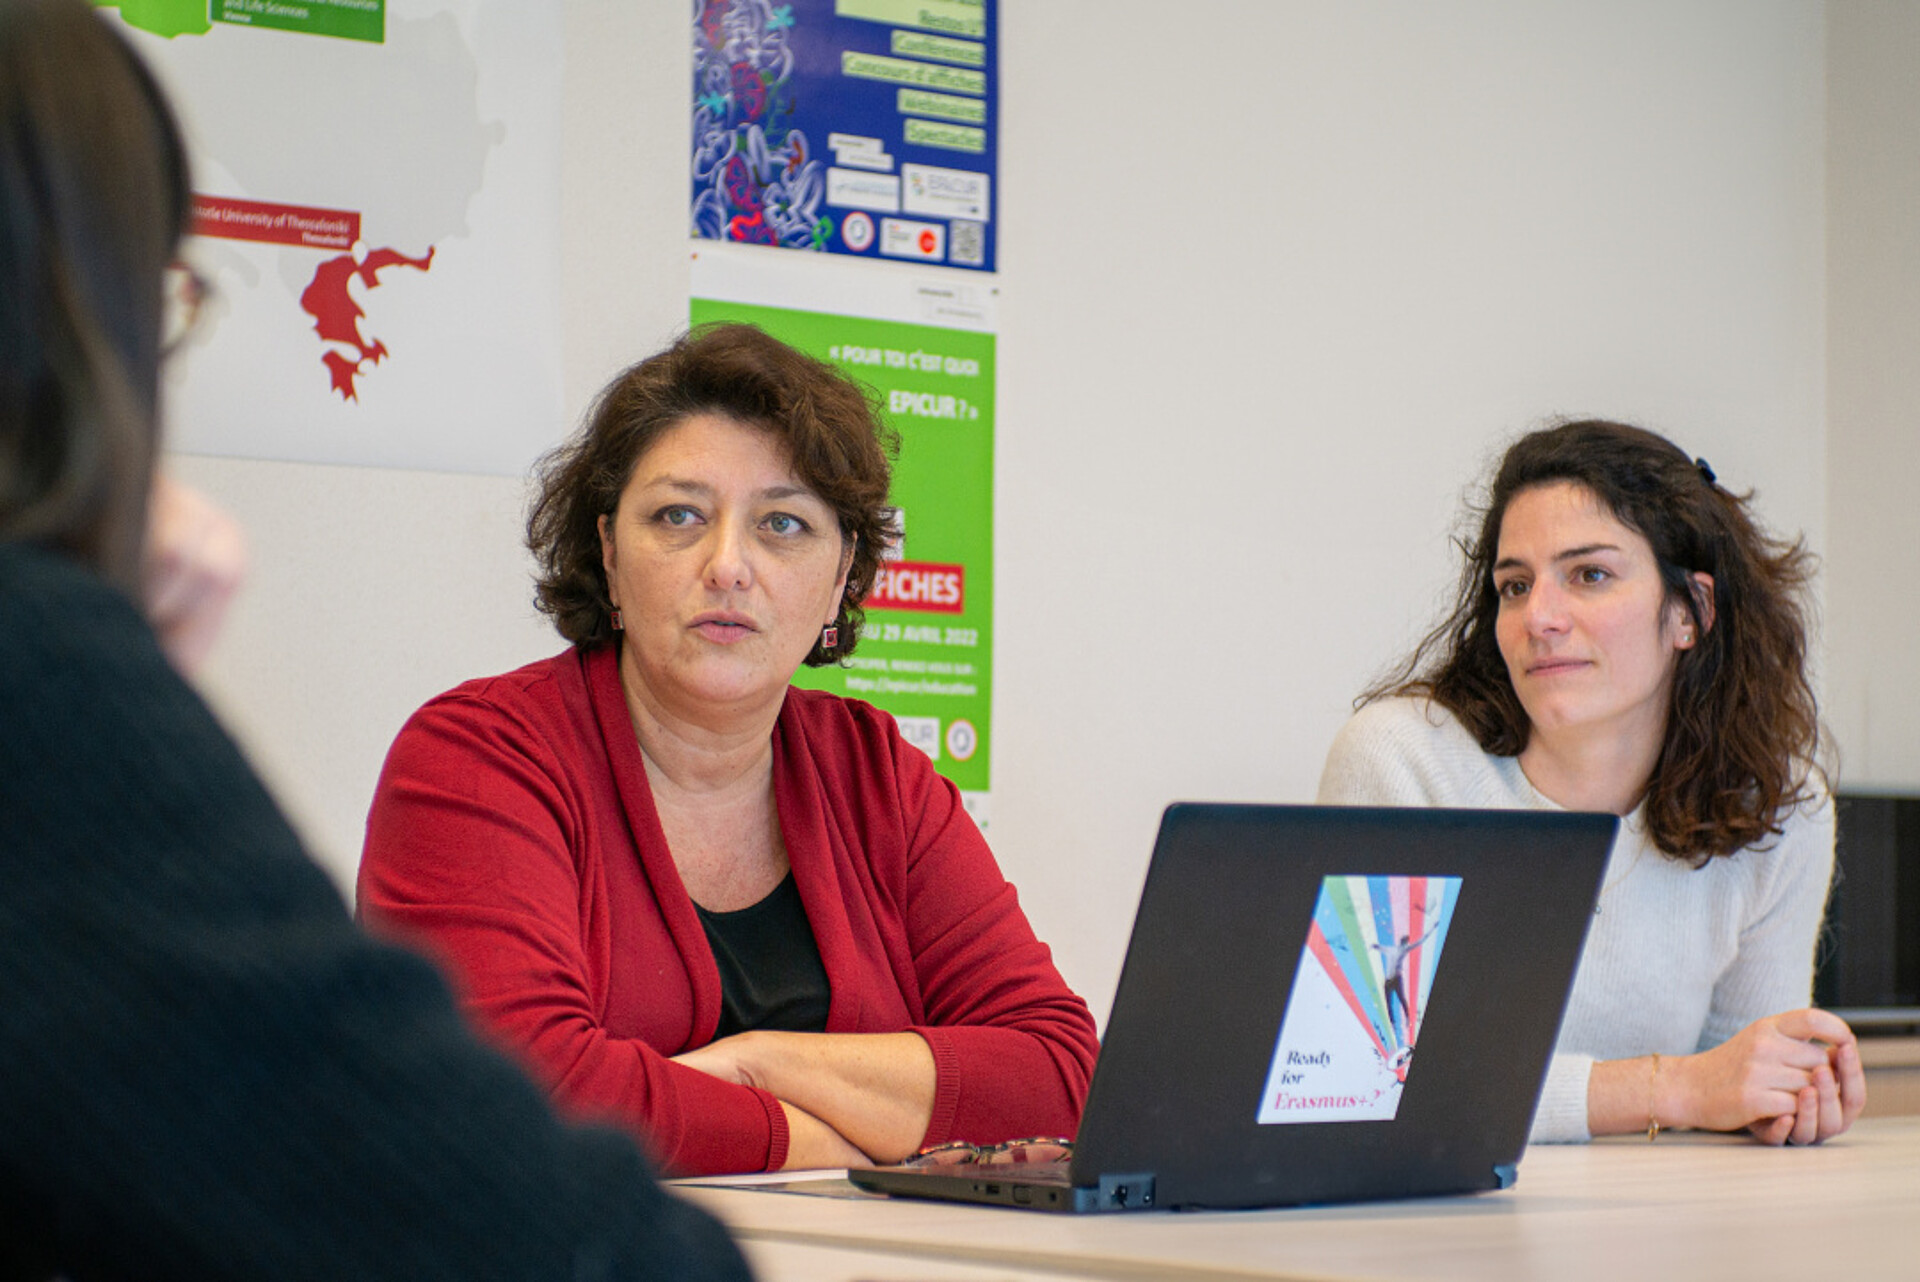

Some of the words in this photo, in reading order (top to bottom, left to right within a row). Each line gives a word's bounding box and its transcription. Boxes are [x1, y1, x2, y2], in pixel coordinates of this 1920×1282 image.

[222, 208, 273, 229] University
[273, 212, 286, 227] of
[287, 214, 350, 233] Thessaloniki
[842, 345, 881, 366] POUR
[884, 349, 906, 368] TOI
[909, 349, 942, 372] C'EST
[944, 356, 979, 376] QUOI
[889, 390, 956, 419] EPICUR
[873, 569, 960, 605] FICHES
[883, 624, 901, 642] 29
[903, 626, 941, 645] AVRIL
[945, 627, 978, 647] 2022
[1286, 1049, 1330, 1069] Ready
[1281, 1070, 1305, 1085] for
